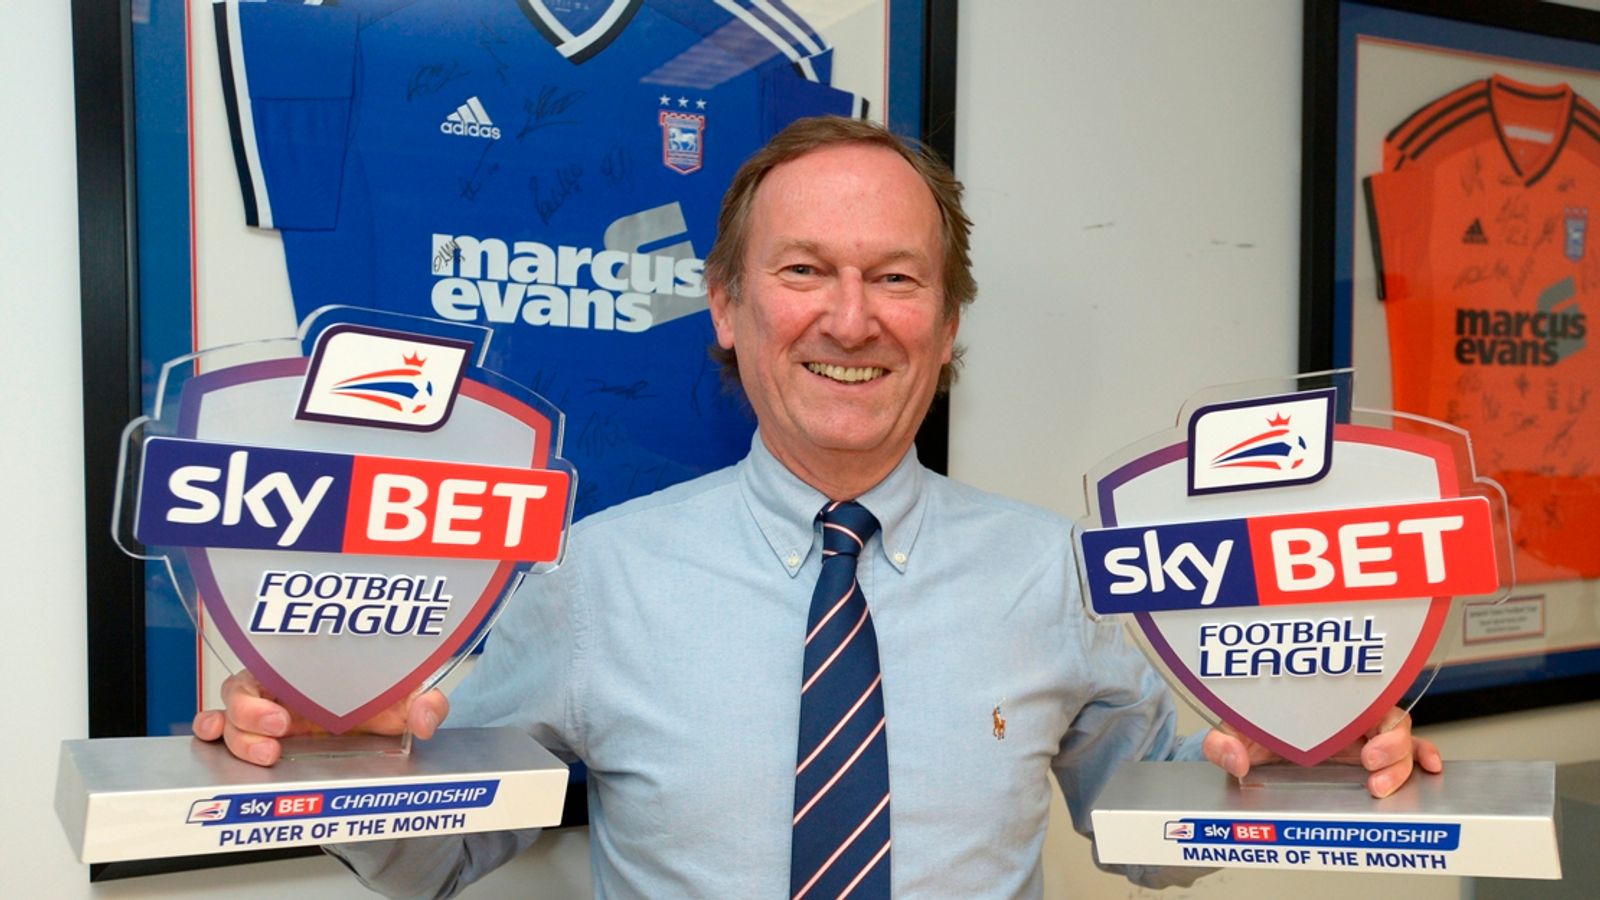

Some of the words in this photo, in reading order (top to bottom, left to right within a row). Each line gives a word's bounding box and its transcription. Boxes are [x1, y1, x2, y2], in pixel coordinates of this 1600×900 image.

[440, 121, 501, 140] adidas
[431, 233, 708, 297] marcus
[431, 277, 653, 333] evans
[1456, 308, 1587, 340] marcus
[1455, 338, 1559, 367] evans
[166, 451, 334, 547] sky
[366, 472, 548, 548] BET
[1104, 529, 1234, 606] sky
[1270, 515, 1464, 593] BET
[258, 572, 451, 603] FOOTBALL
[249, 602, 448, 636] LEAGUE
[1199, 618, 1385, 647] FOOTBALL
[1199, 645, 1384, 678] LEAGUE
[240, 798, 272, 818] sky
[278, 797, 320, 814] BET
[330, 787, 487, 810] CHAMPIONSHIP
[219, 824, 303, 846] PLAYER
[311, 821, 339, 840] OF
[346, 818, 386, 837] THE
[392, 813, 466, 833] MONTH
[1204, 824, 1231, 841] sky
[1236, 825, 1272, 840] BET
[1283, 826, 1449, 844] CHAMPIONSHIP
[1183, 847, 1279, 864] MANAGER
[1285, 850, 1311, 865] OF
[1318, 850, 1358, 867] THE
[1366, 852, 1447, 870] MONTH
